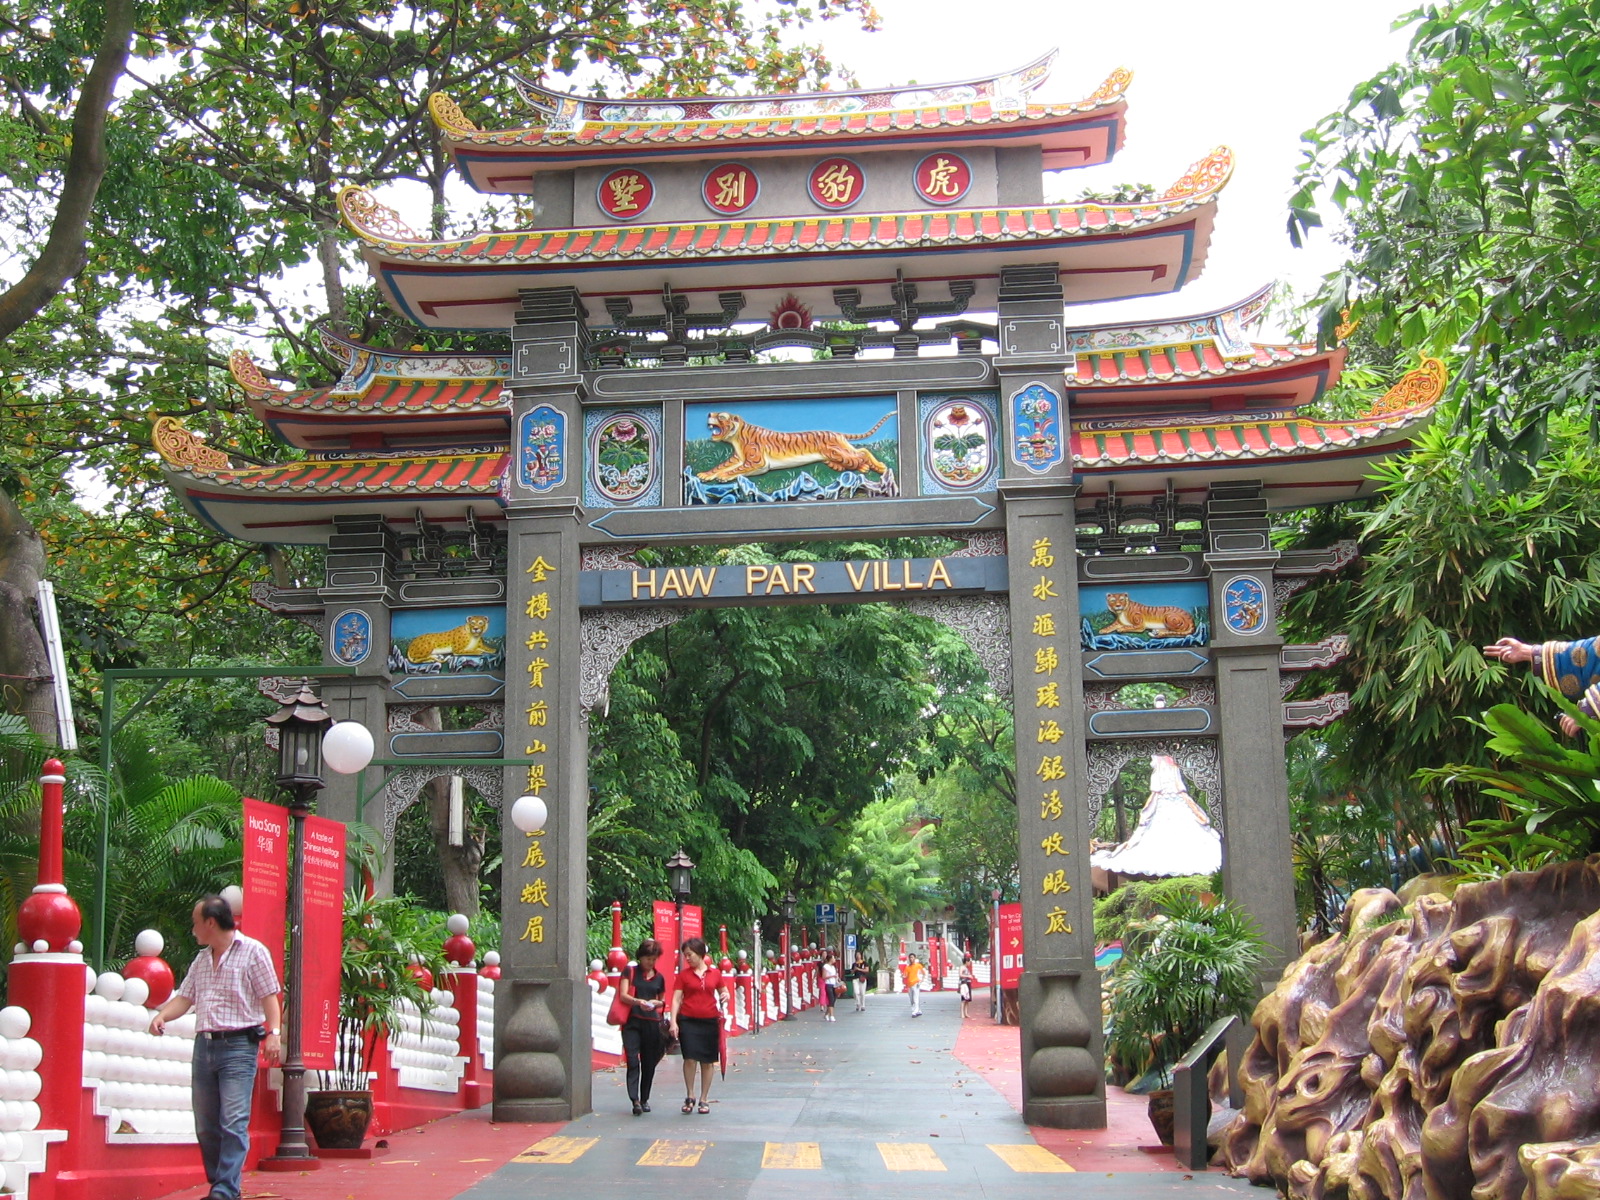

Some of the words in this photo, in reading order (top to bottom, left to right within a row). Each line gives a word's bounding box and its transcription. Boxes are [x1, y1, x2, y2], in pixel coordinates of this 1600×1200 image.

[632, 566, 716, 598] HAW
[746, 563, 816, 595] PAR
[845, 559, 952, 591] VILLA
[520, 556, 557, 943] 金樽共賞前山翠展蛾眉
[249, 816, 264, 829] Hua
[264, 819, 281, 837] Song
[821, 904, 830, 915] P
[848, 935, 854, 945] P
